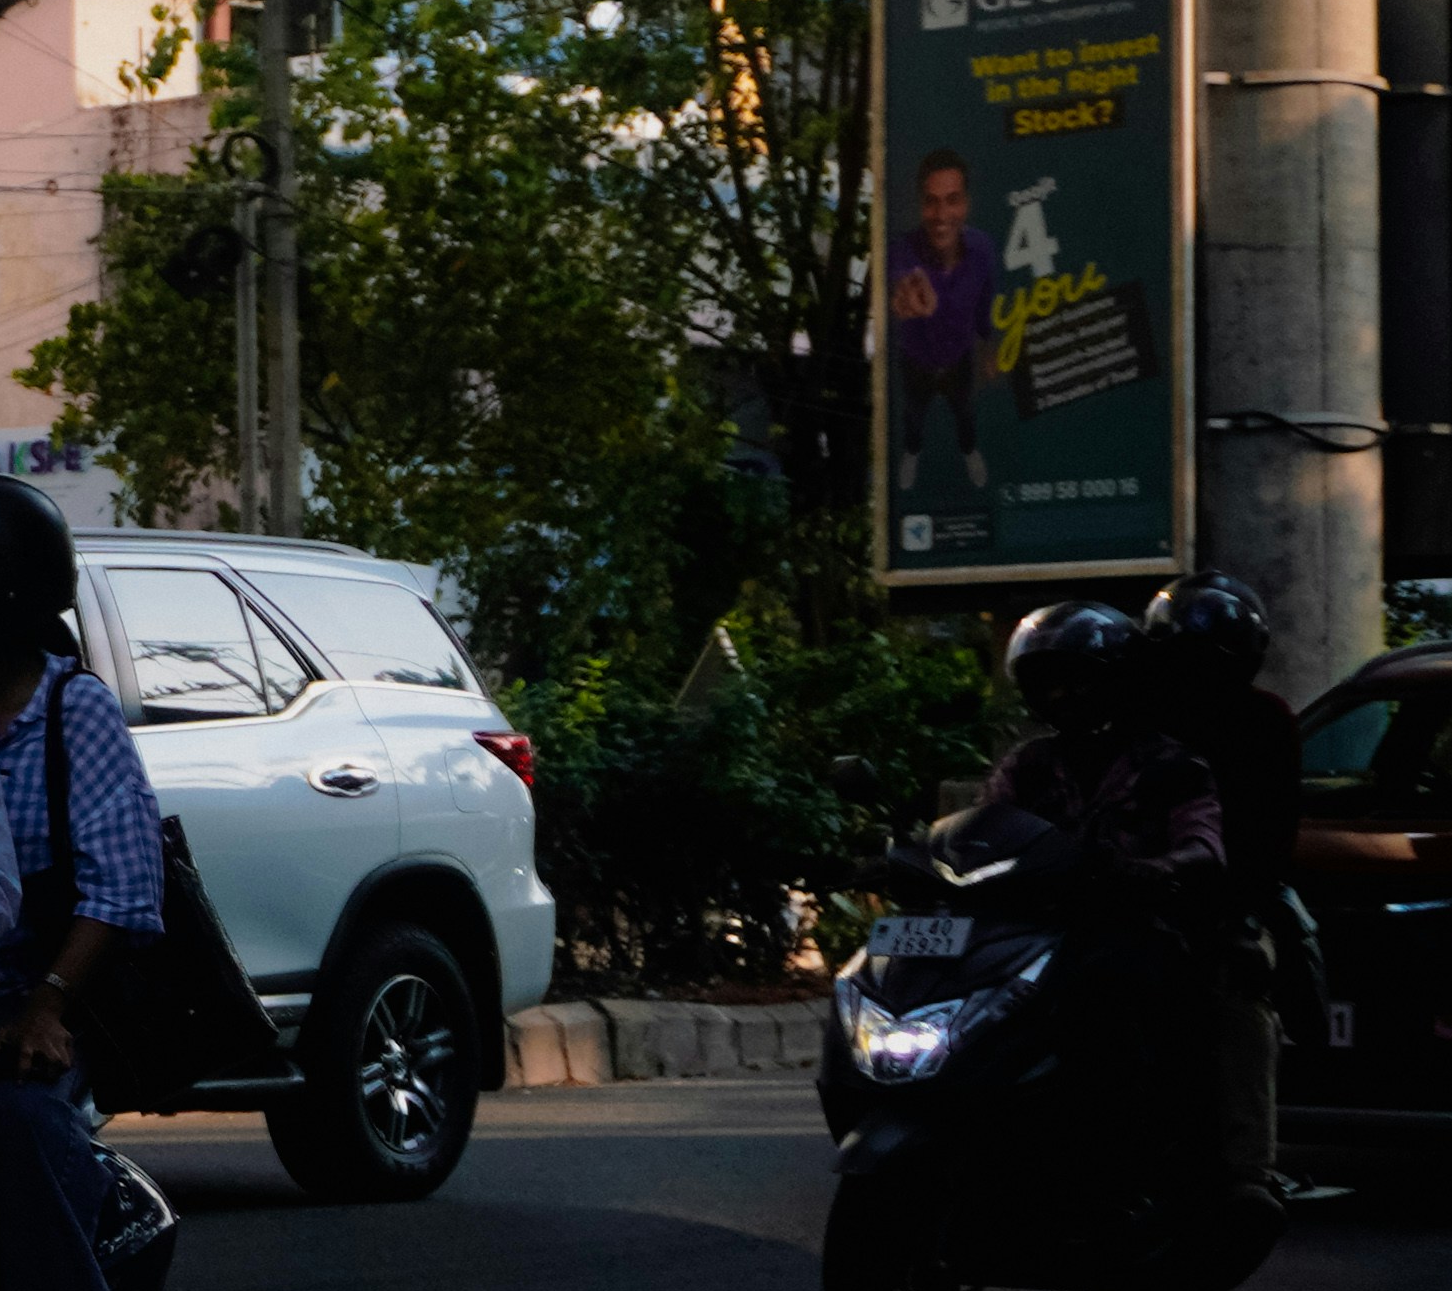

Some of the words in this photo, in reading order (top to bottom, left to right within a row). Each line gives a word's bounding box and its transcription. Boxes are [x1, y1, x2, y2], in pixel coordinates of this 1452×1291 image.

[969, 50, 1040, 79] Want
[1043, 47, 1074, 69] to
[1077, 31, 1161, 64] invest
[985, 79, 1013, 104] in
[1016, 76, 1062, 100] the
[1065, 62, 1140, 95] Right
[1012, 98, 1116, 137] Stock?
[1002, 200, 1061, 279] 4
[989, 259, 1109, 375] you
